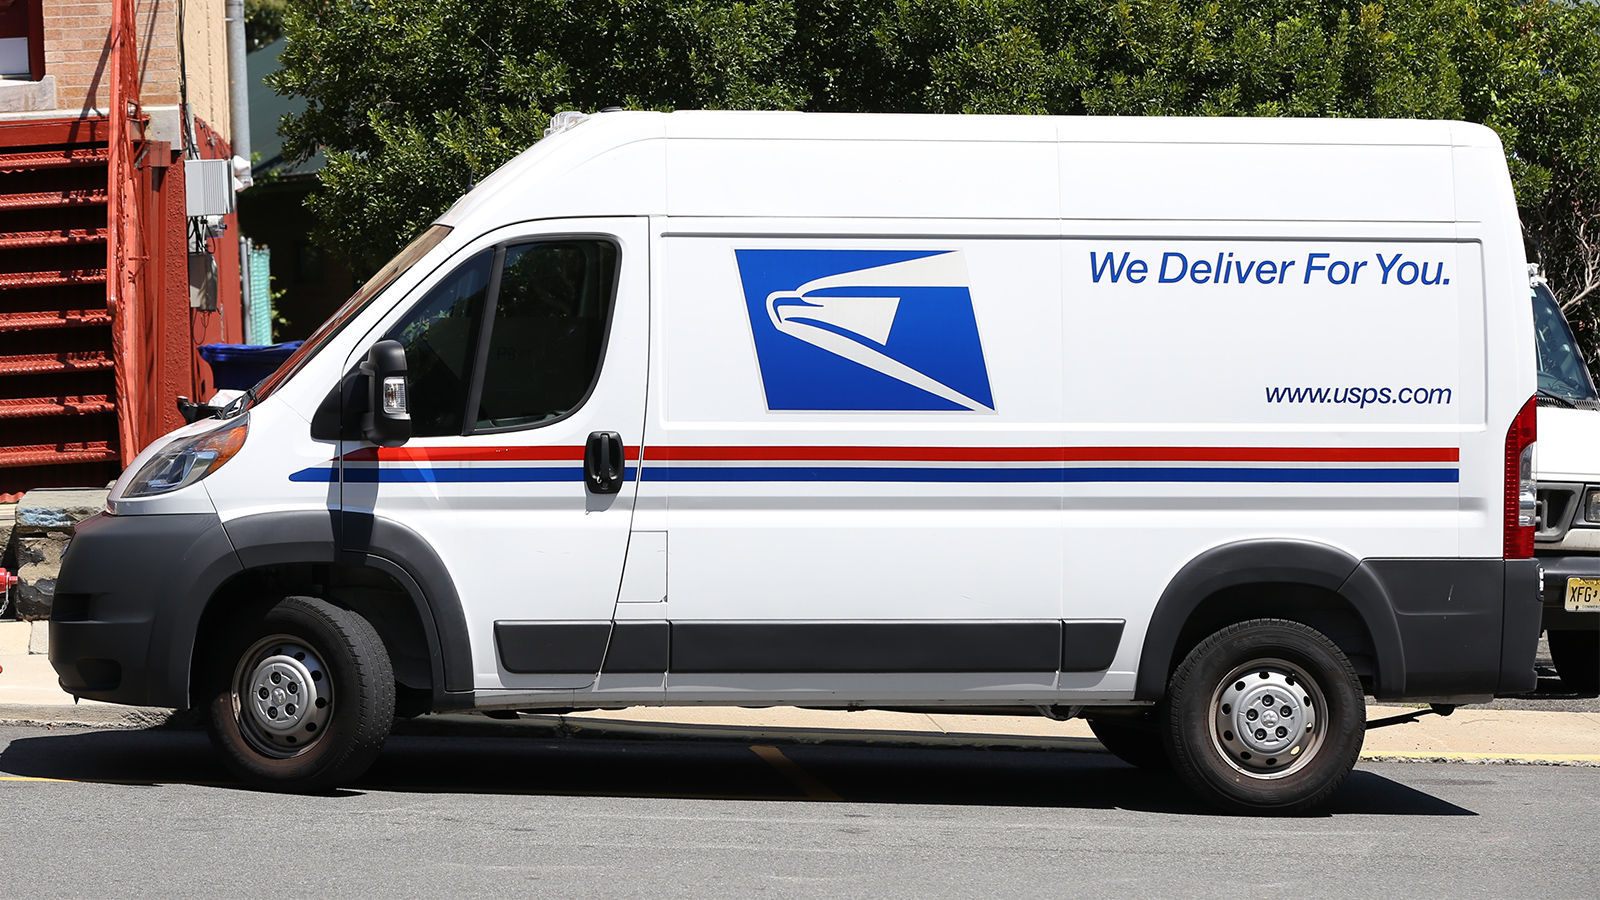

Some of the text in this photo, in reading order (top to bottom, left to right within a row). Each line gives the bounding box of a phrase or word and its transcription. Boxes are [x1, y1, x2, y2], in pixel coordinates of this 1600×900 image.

[1091, 252, 1450, 286] We Deliver For You.
[1266, 386, 1452, 408] www.usps.com
